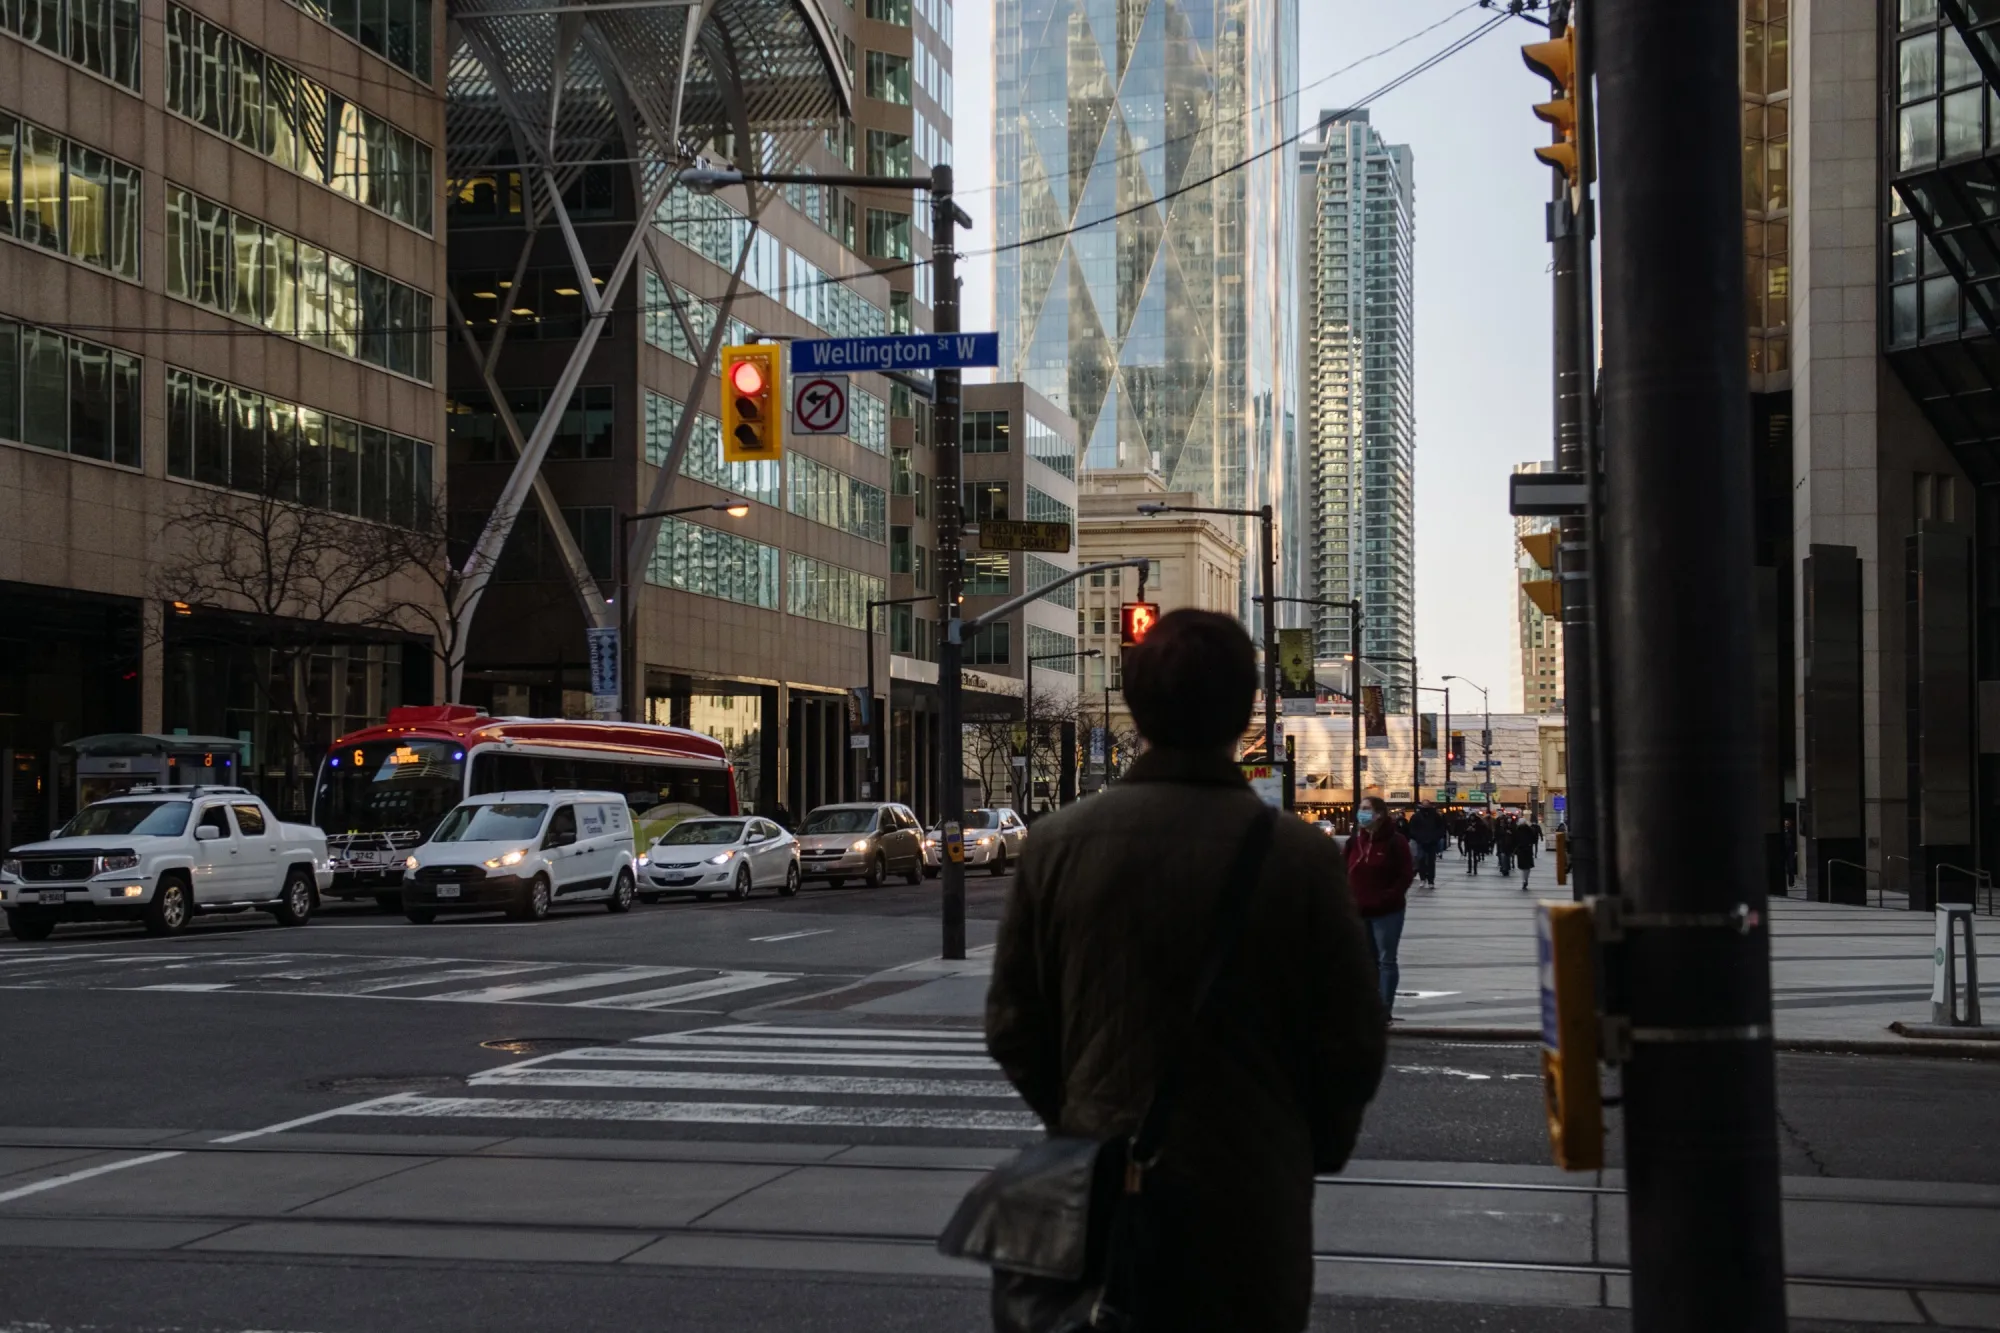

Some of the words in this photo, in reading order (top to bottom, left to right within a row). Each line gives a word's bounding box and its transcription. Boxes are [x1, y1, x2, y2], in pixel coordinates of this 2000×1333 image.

[812, 341, 931, 369] Wellington
[937, 338, 949, 351] St
[956, 336, 976, 360] W
[1020, 537, 1057, 549] SIGNALS
[354, 750, 363, 766] 6
